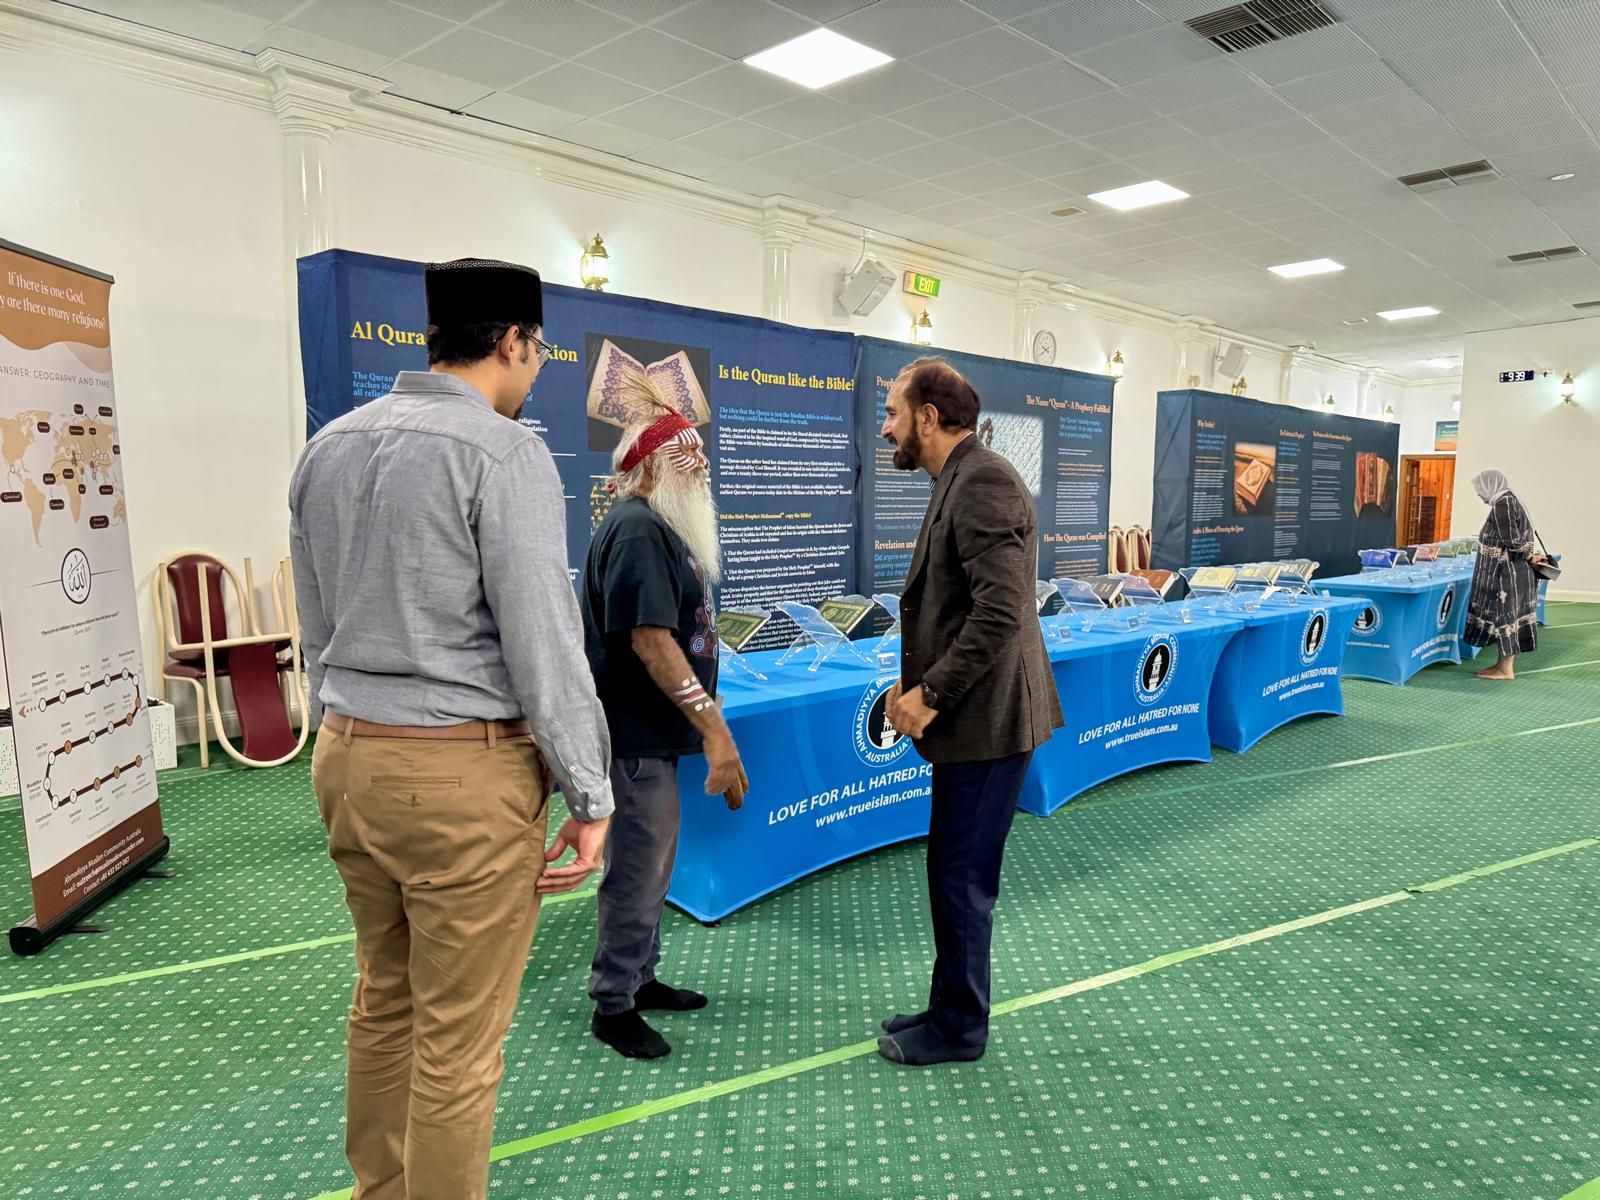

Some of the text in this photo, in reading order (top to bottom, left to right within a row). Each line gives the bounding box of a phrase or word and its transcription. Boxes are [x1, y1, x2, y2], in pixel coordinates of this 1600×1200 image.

[8, 271, 16, 287] If
[16, 274, 40, 293] there
[40, 281, 49, 295] is
[50, 287, 65, 299] one
[919, 278, 935, 294] EXIT
[7, 297, 22, 310] are
[22, 297, 46, 316] there
[48, 307, 70, 324] many
[350, 321, 426, 346] Al Qura
[33, 370, 76, 383] GEOGRAPHY
[79, 376, 94, 386] AND
[95, 378, 110, 388] TIME
[352, 371, 394, 382] The Quran
[719, 364, 855, 391] Is the Quran like the Bible?
[874, 538, 917, 550] Revelation and
[1262, 681, 1279, 697] LOVE
[855, 688, 877, 753] AHMADIYYA
[1078, 703, 1200, 745] LOVE FOR ALL HATRED FOR NONE
[1105, 723, 1179, 750] www.trueislam.com.au
[865, 742, 908, 763] AUSTRALIA
[768, 764, 933, 825] LOVE FOR ALL HATRED FO
[815, 785, 932, 828] www.trueislam.com.a
